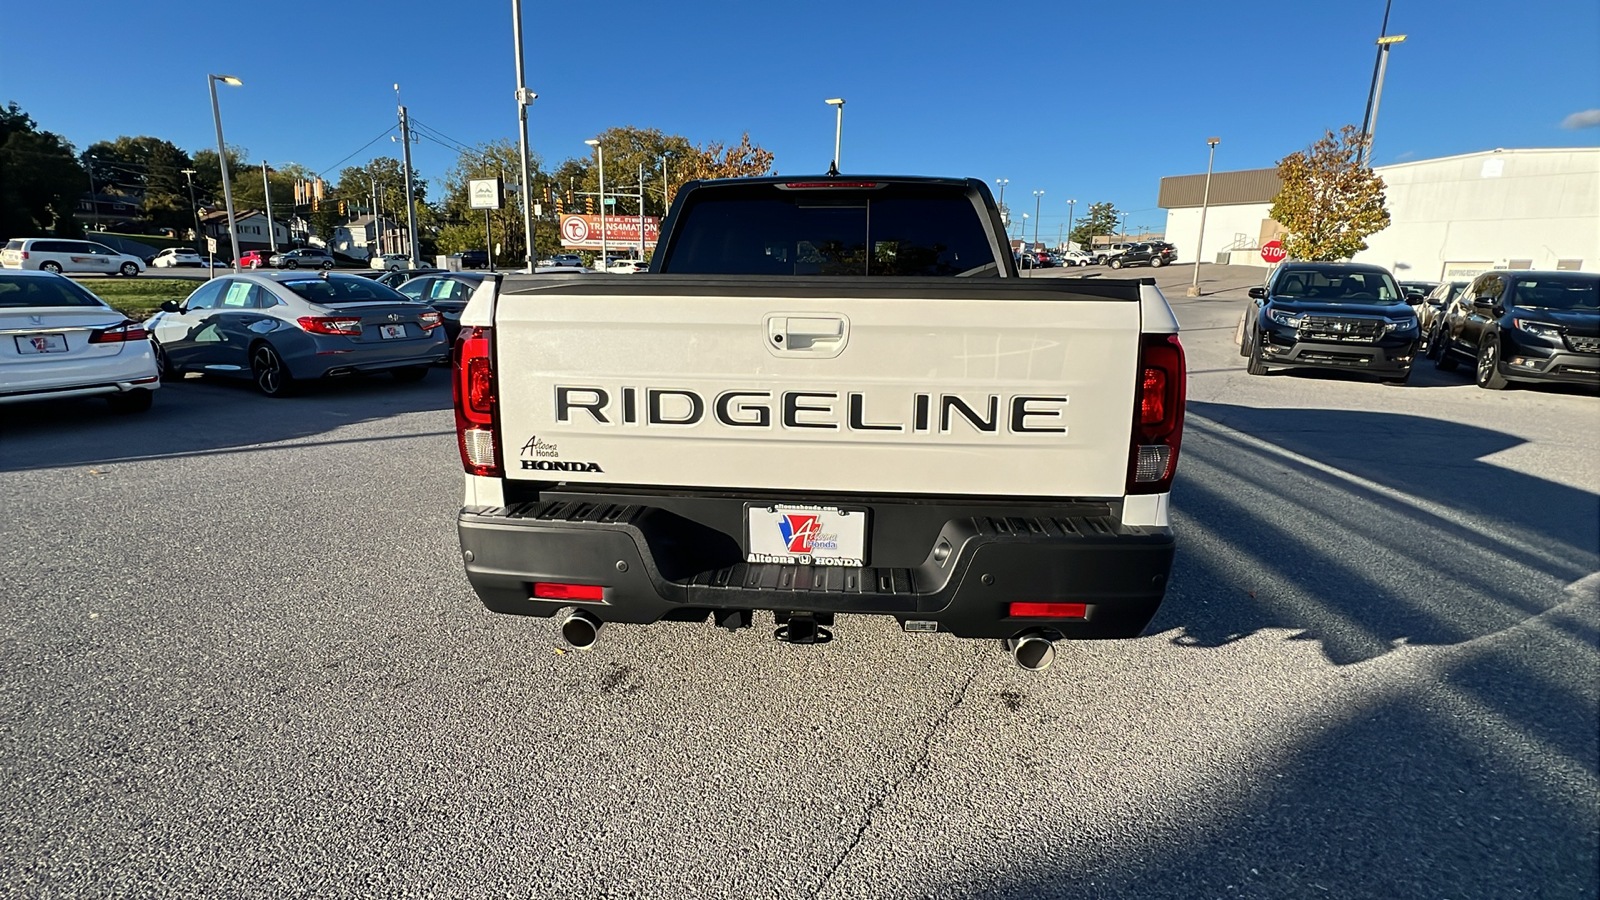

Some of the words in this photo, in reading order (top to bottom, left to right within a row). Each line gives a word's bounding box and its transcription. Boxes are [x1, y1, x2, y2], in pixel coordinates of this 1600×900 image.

[589, 222, 657, 232] TRNS4MATON
[1262, 246, 1286, 257] STOP
[556, 385, 1068, 434] RIDGELINE
[520, 460, 605, 473] HONDA
[807, 539, 837, 549] Honda
[747, 553, 795, 564] Altoona
[815, 557, 863, 567] HONDA
